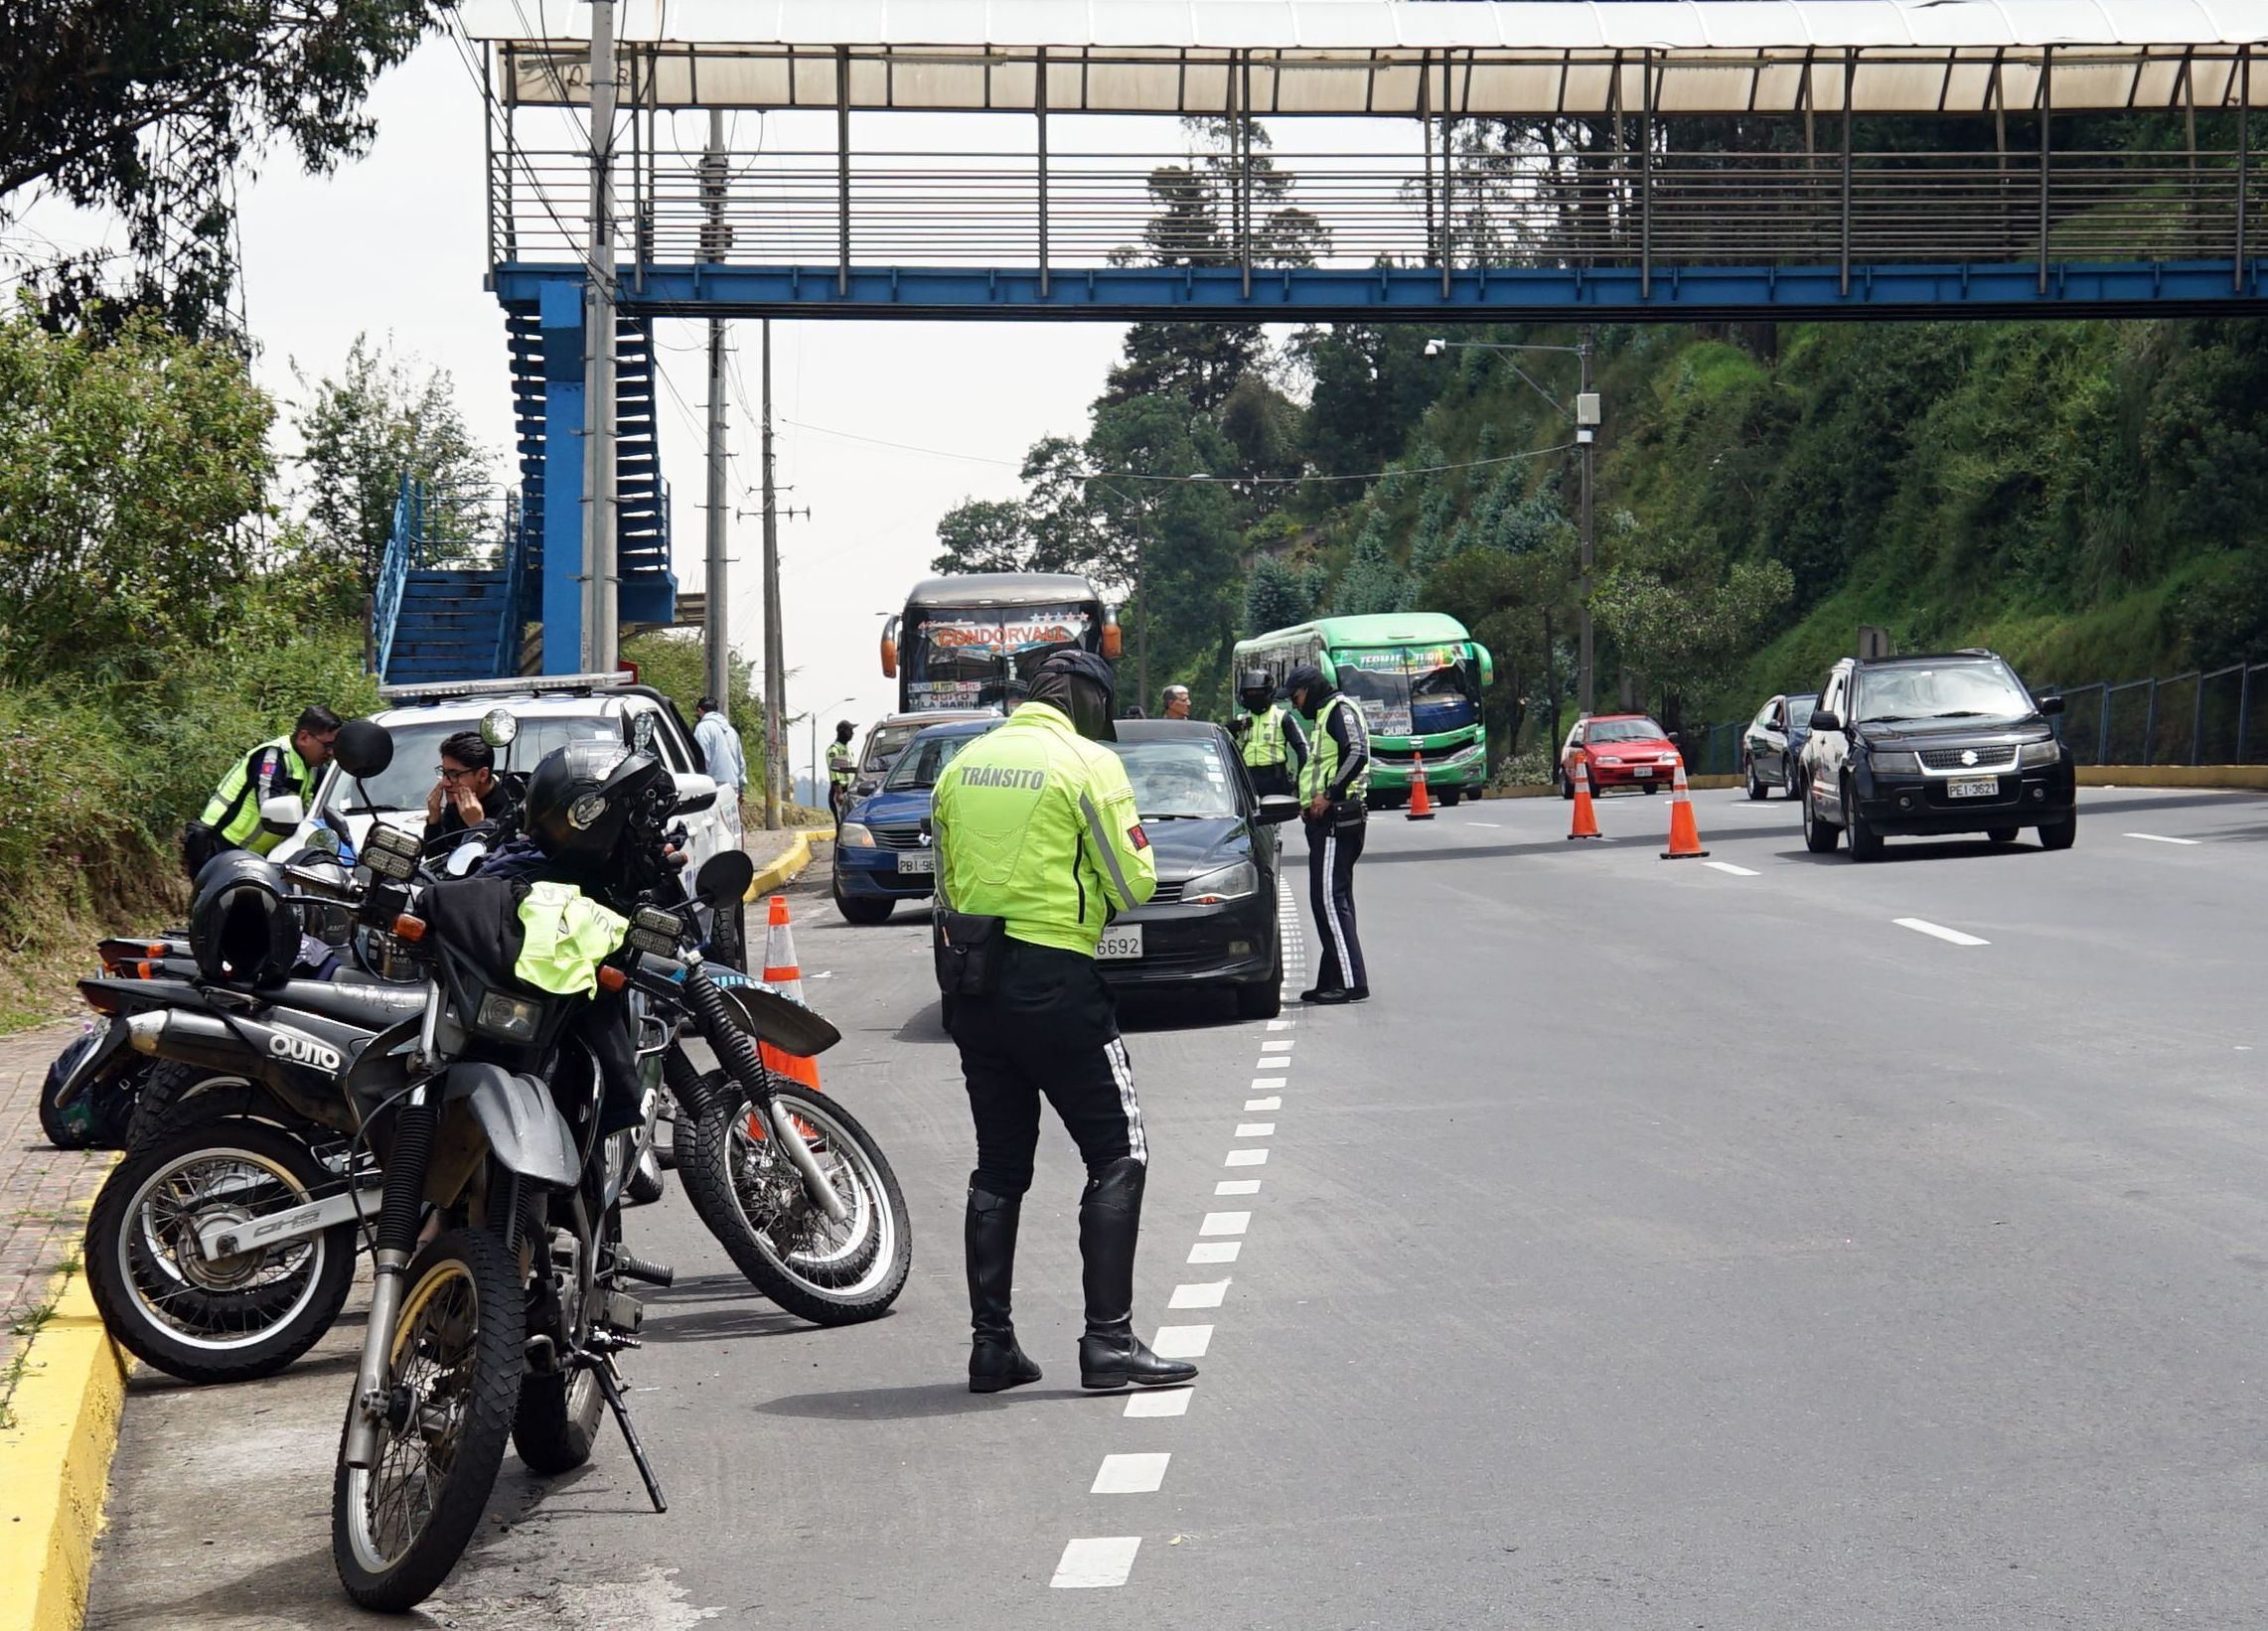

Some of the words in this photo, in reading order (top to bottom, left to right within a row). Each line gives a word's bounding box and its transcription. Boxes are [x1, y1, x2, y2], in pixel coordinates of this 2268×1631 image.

[938, 625, 1068, 646] CONDORVALL
[961, 763, 1045, 791] TRÁNSITO
[1097, 938, 1139, 955] 6692
[269, 1034, 340, 1069] QUITO
[604, 1135, 621, 1174] 911
